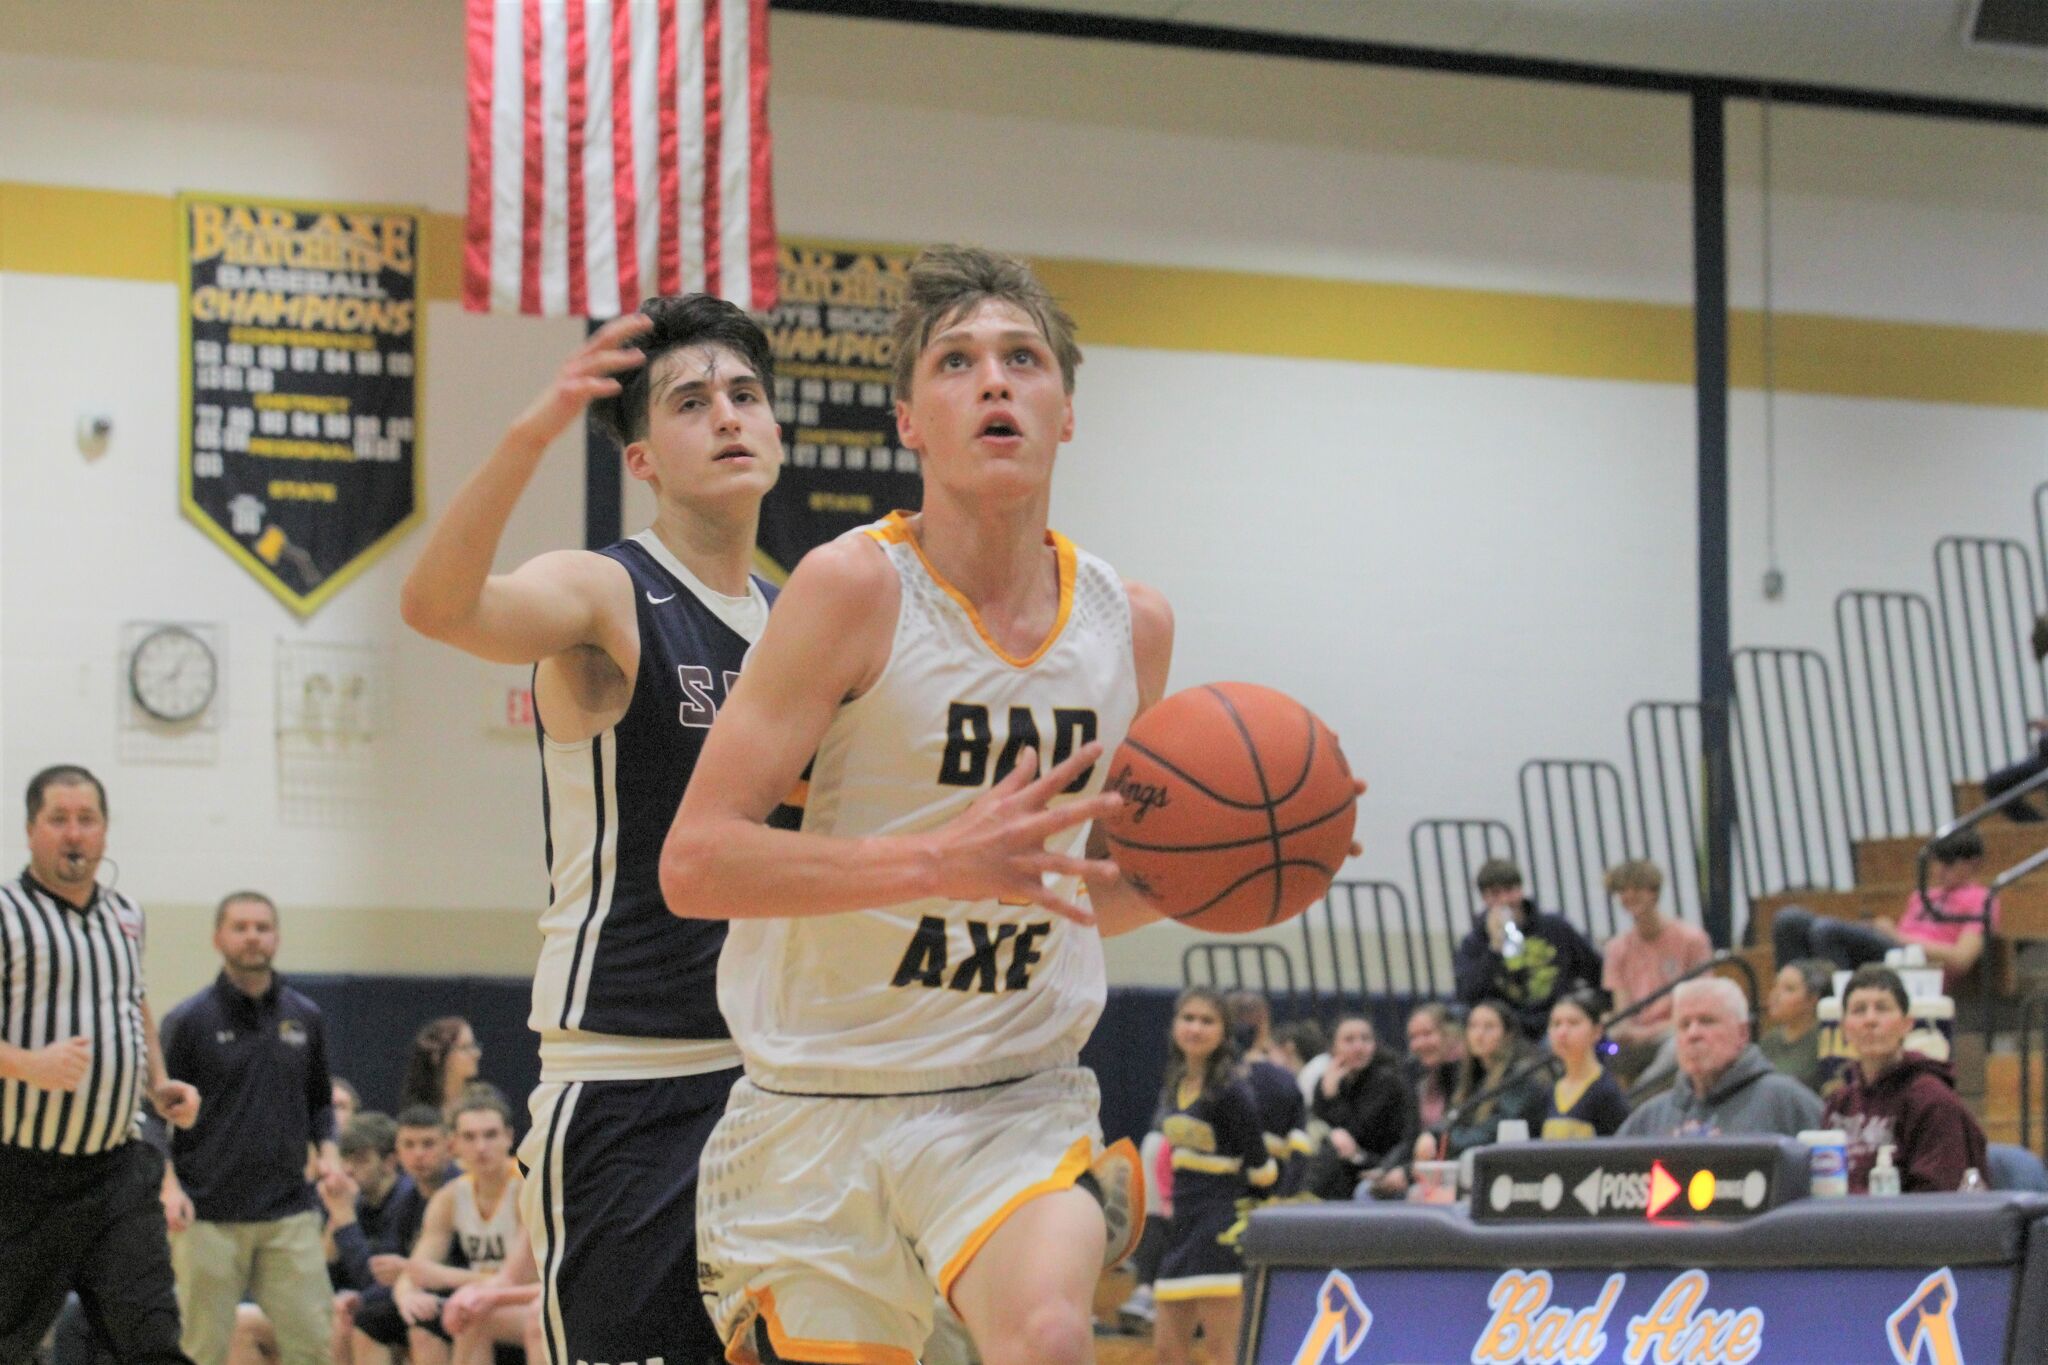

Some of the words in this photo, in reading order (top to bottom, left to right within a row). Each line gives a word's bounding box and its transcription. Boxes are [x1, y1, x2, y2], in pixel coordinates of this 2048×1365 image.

[192, 205, 297, 262] BAD
[312, 212, 413, 272] AXE
[193, 286, 412, 335] CHAMPIONS
[216, 264, 387, 298] BASEBALL
[938, 701, 1098, 794] BAD
[891, 914, 1051, 993] AXE
[1600, 1172, 1652, 1210] POSS
[1471, 1268, 1626, 1365] Bad
[1623, 1268, 1765, 1365] Axe
